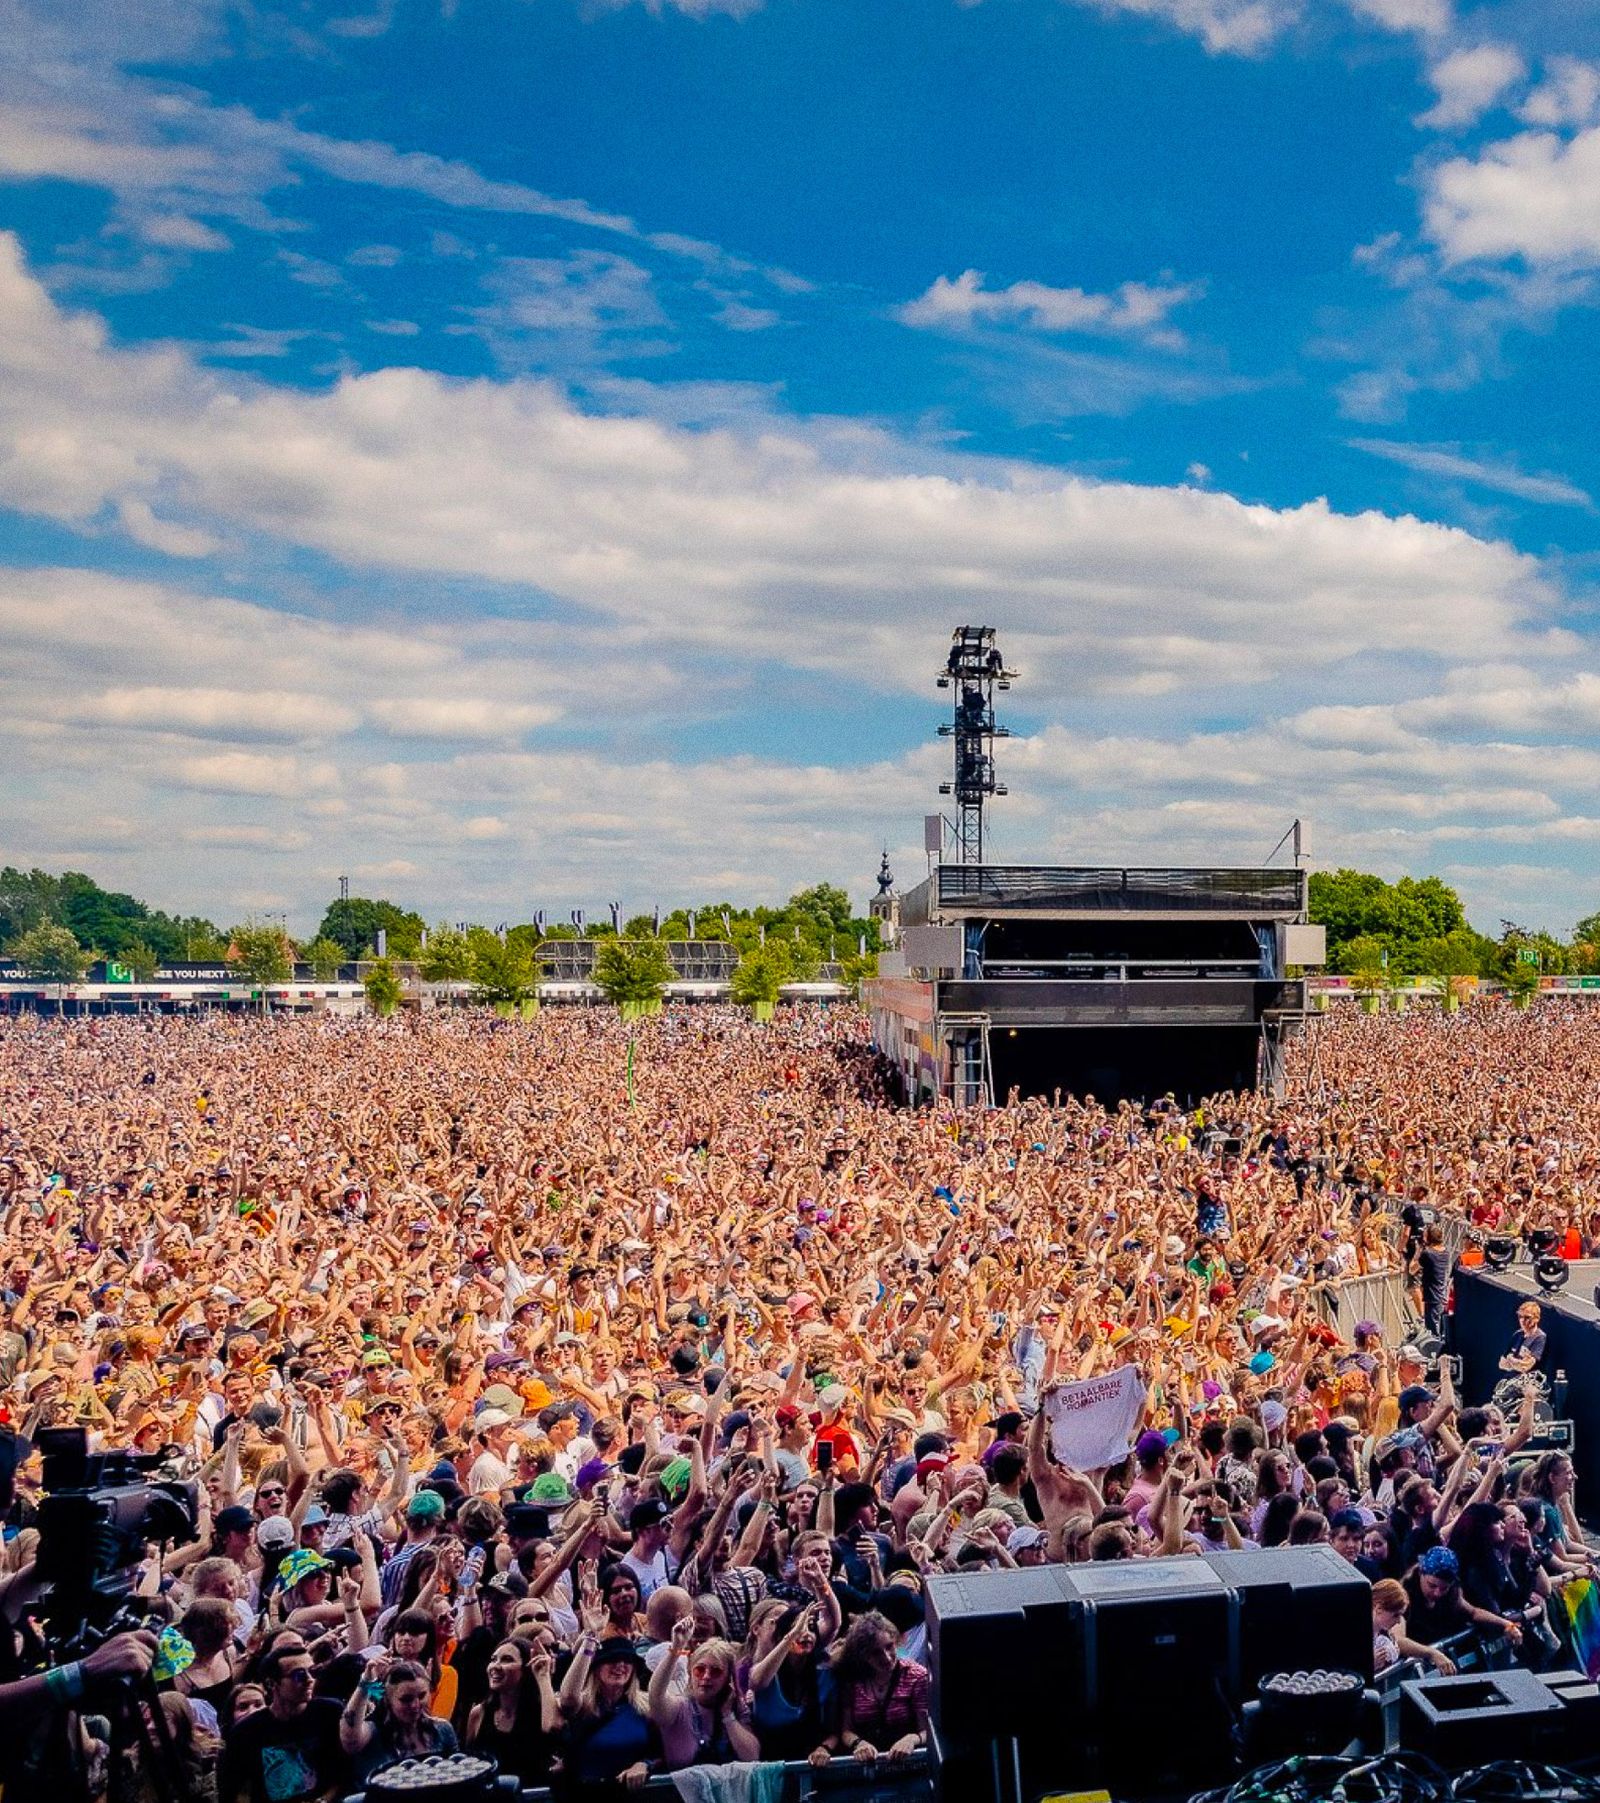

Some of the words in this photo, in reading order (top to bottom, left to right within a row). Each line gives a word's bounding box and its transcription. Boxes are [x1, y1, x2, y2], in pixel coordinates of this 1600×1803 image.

[2, 969, 26, 979] YOU
[174, 969, 196, 979] YOU
[197, 969, 225, 979] NEXT
[1061, 1379, 1123, 1406] BETAALBARE
[1066, 1389, 1121, 1411] ROMANTIEK
